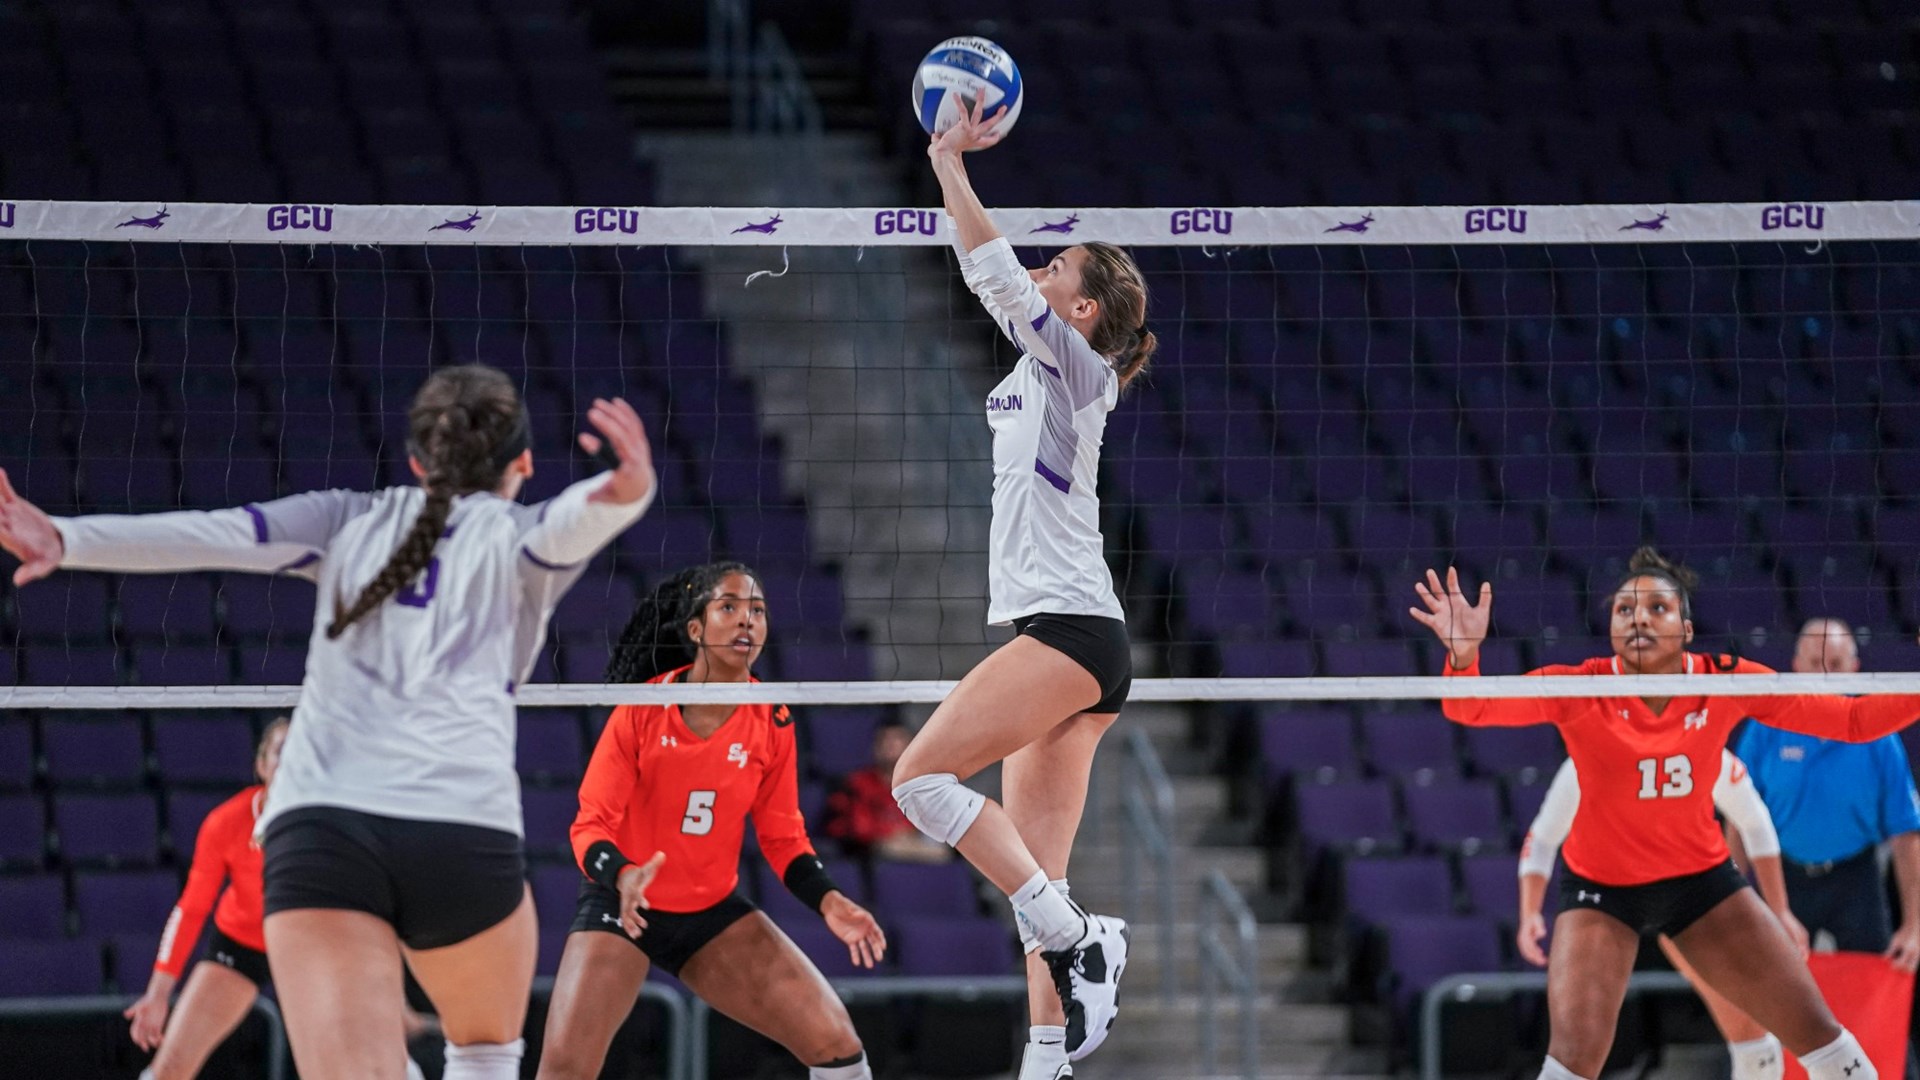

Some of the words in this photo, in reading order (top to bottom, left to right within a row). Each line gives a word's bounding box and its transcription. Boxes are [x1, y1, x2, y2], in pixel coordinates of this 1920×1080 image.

[267, 205, 332, 232] GCU
[575, 208, 639, 235] GCU
[874, 209, 937, 237] GCU
[1170, 208, 1233, 236] GCU
[1465, 207, 1527, 233] GCU
[1760, 204, 1824, 231] GCU
[1637, 753, 1694, 800] 13
[681, 789, 717, 836] 5
